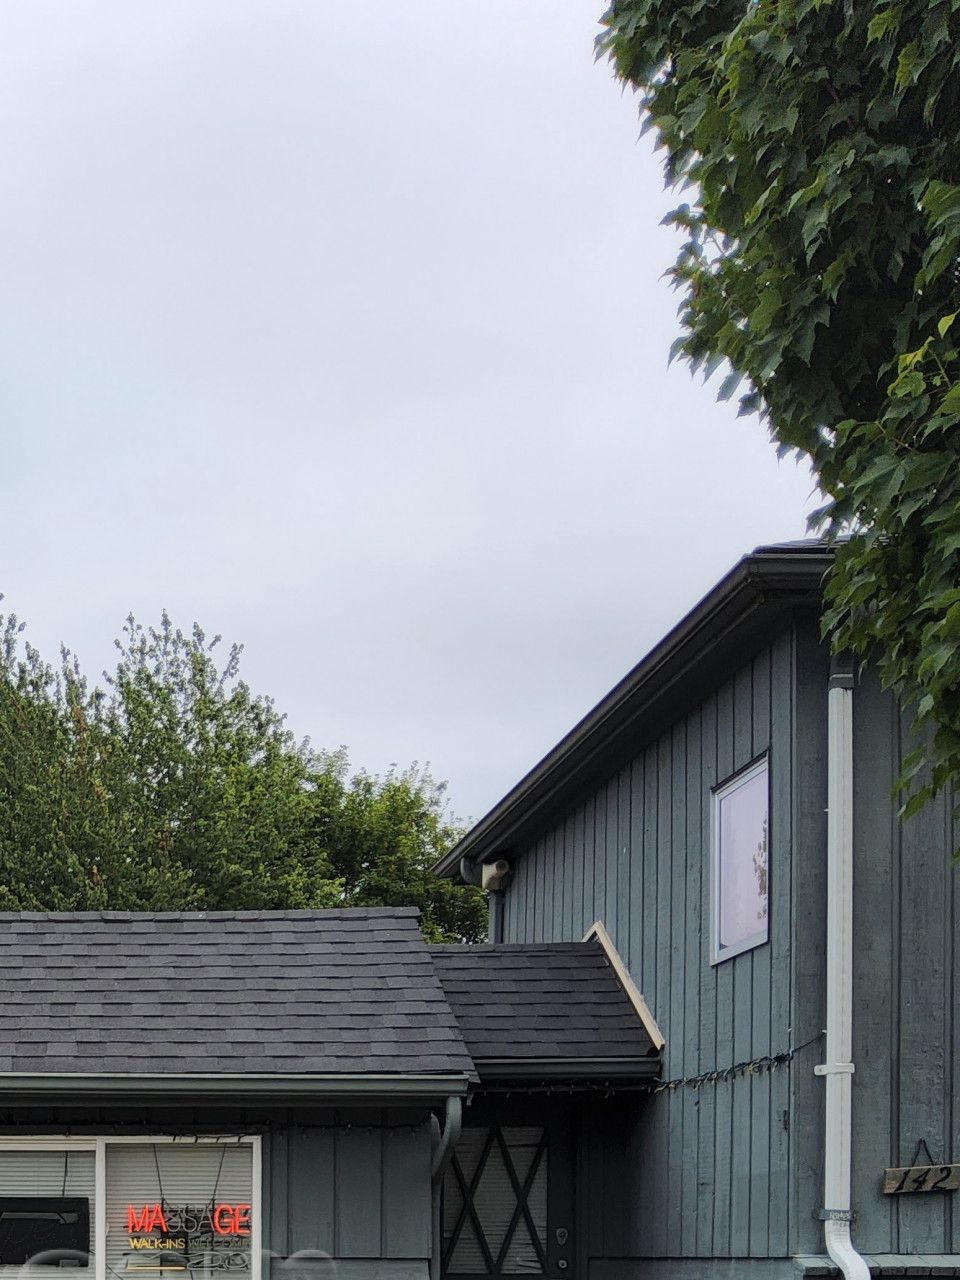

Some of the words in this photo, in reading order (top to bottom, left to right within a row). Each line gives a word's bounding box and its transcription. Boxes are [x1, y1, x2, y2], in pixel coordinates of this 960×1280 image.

[894, 1167, 952, 1192] 142
[126, 1203, 252, 1236] MASSAGE
[129, 1238, 186, 1250] WALK-INS
